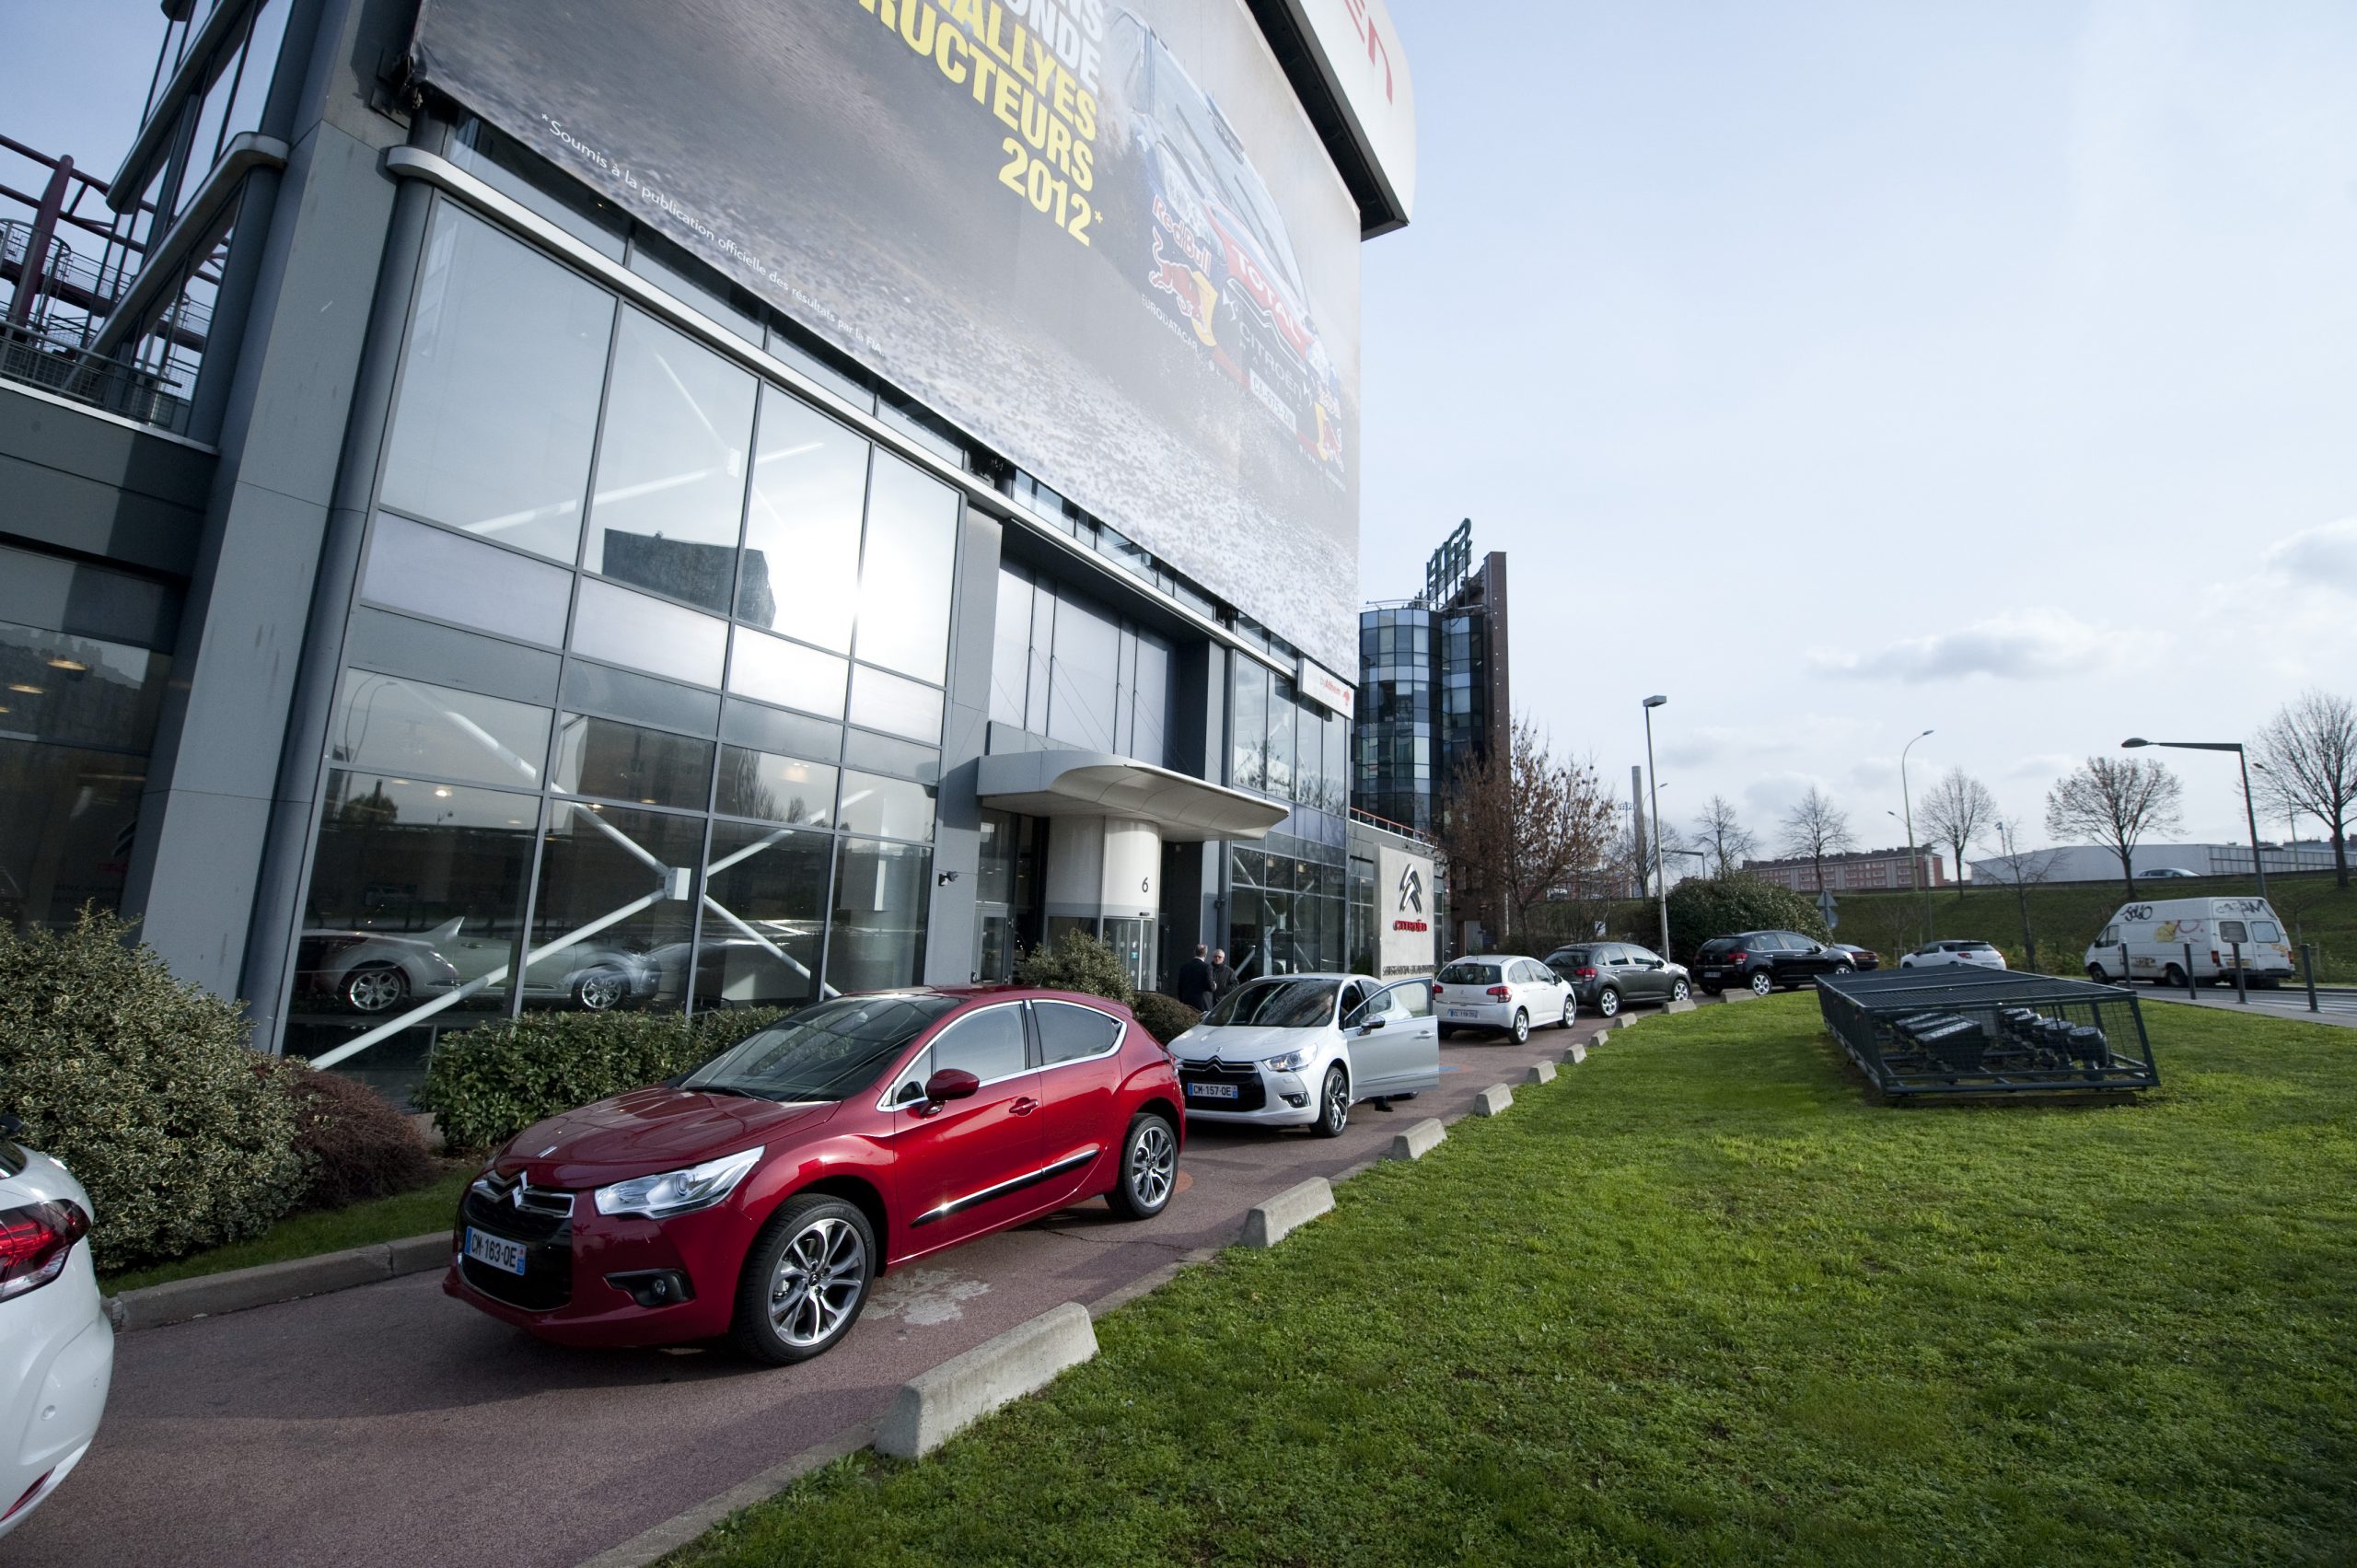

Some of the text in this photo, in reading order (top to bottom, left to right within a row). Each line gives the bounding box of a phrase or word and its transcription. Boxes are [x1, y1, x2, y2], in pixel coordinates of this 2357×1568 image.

[1004, 0, 1102, 96] NDE
[611, 162, 621, 178] à
[625, 169, 638, 190] la
[641, 185, 715, 242] publication
[718, 238, 767, 276] officielle
[769, 270, 790, 292] des
[792, 281, 836, 323] résultats
[838, 319, 854, 335] par
[855, 327, 865, 343] la
[1230, 244, 1302, 344] TOTAL
[1142, 877, 1149, 893] 6
